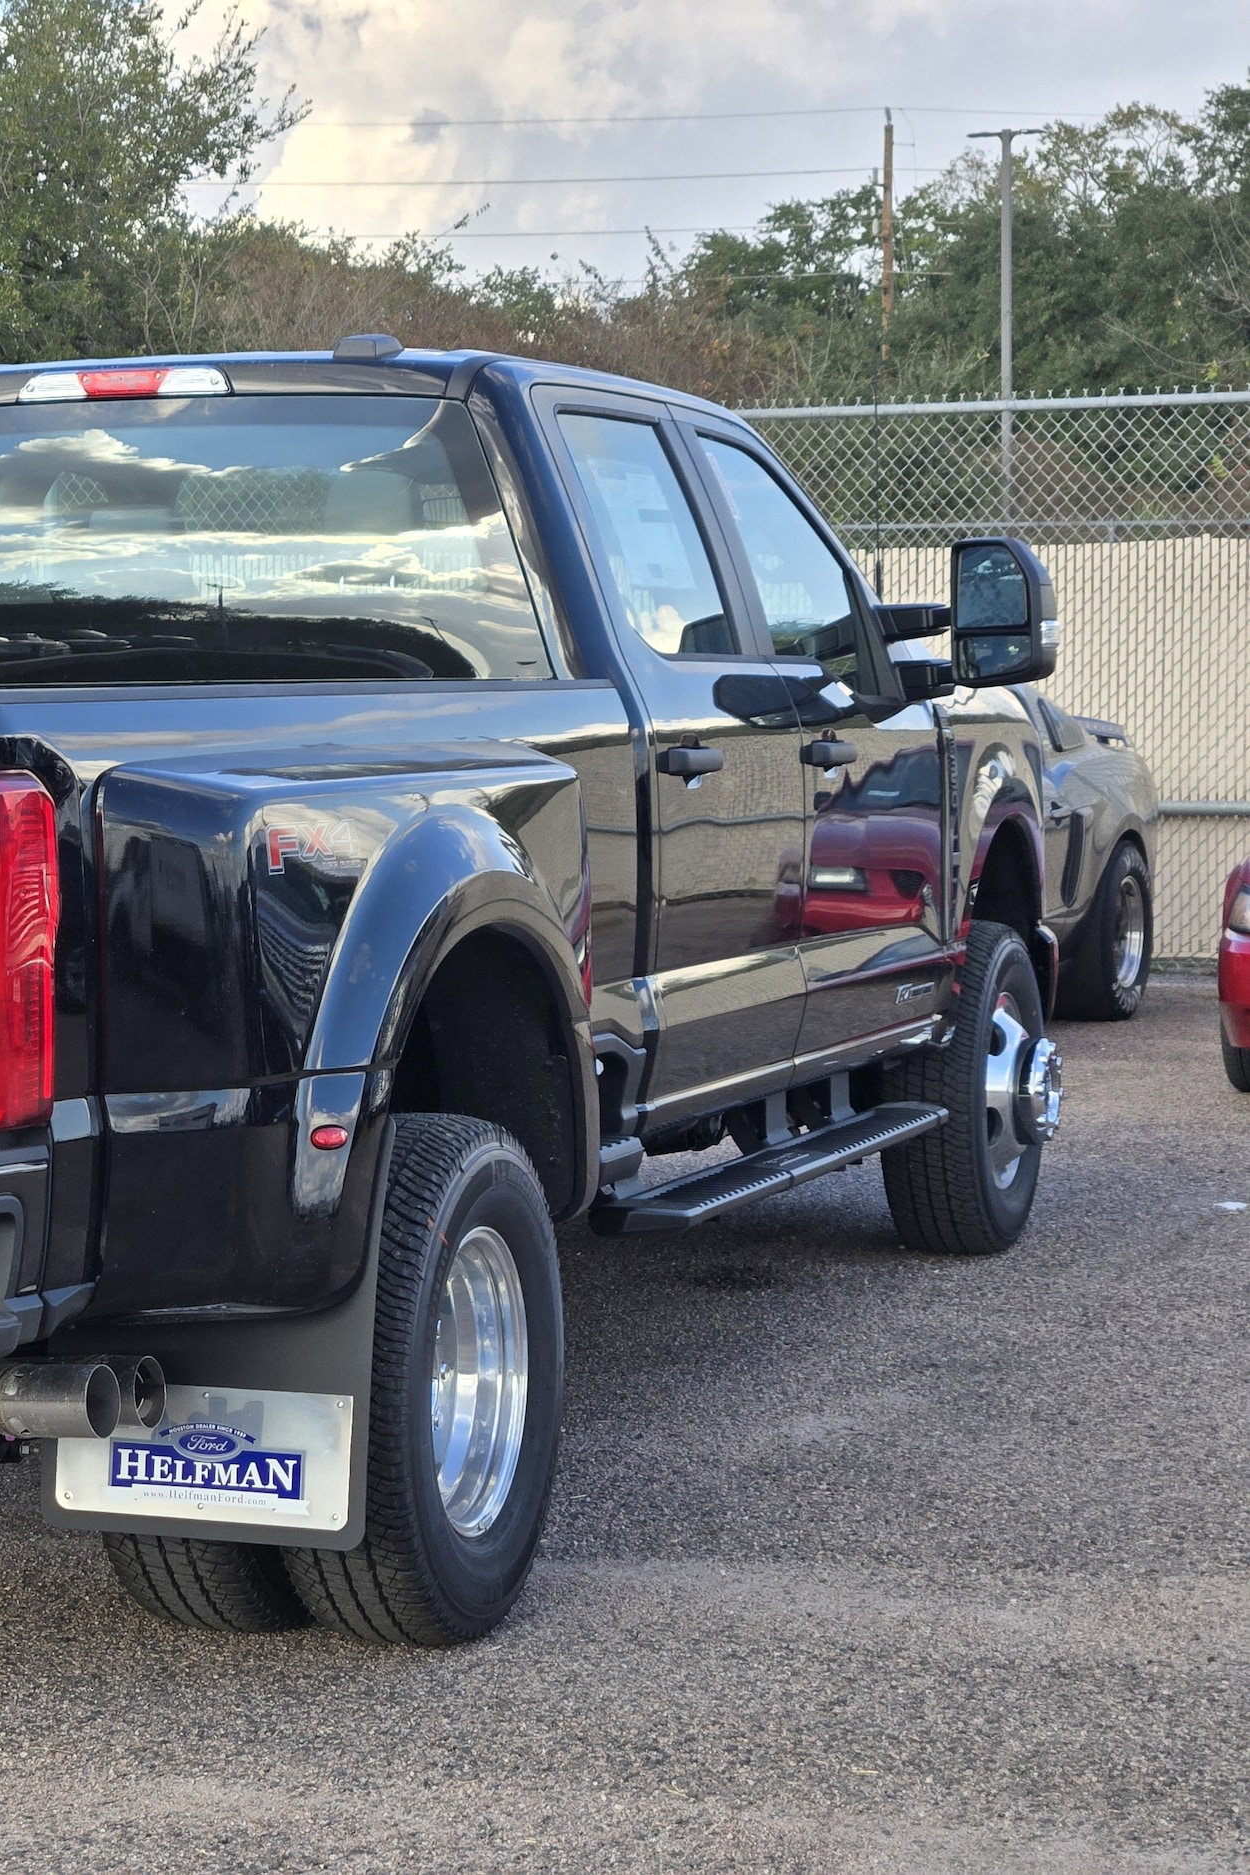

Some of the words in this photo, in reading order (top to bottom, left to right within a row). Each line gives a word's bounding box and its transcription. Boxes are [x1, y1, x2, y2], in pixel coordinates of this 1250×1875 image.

[266, 819, 361, 875] FX4
[168, 1423, 195, 1434] HOUSTON
[216, 1424, 234, 1434] SINCE
[186, 1434, 229, 1452] Ford
[116, 1448, 298, 1491] HELFMAN
[143, 1489, 267, 1507] www.HelfmanFord.com
